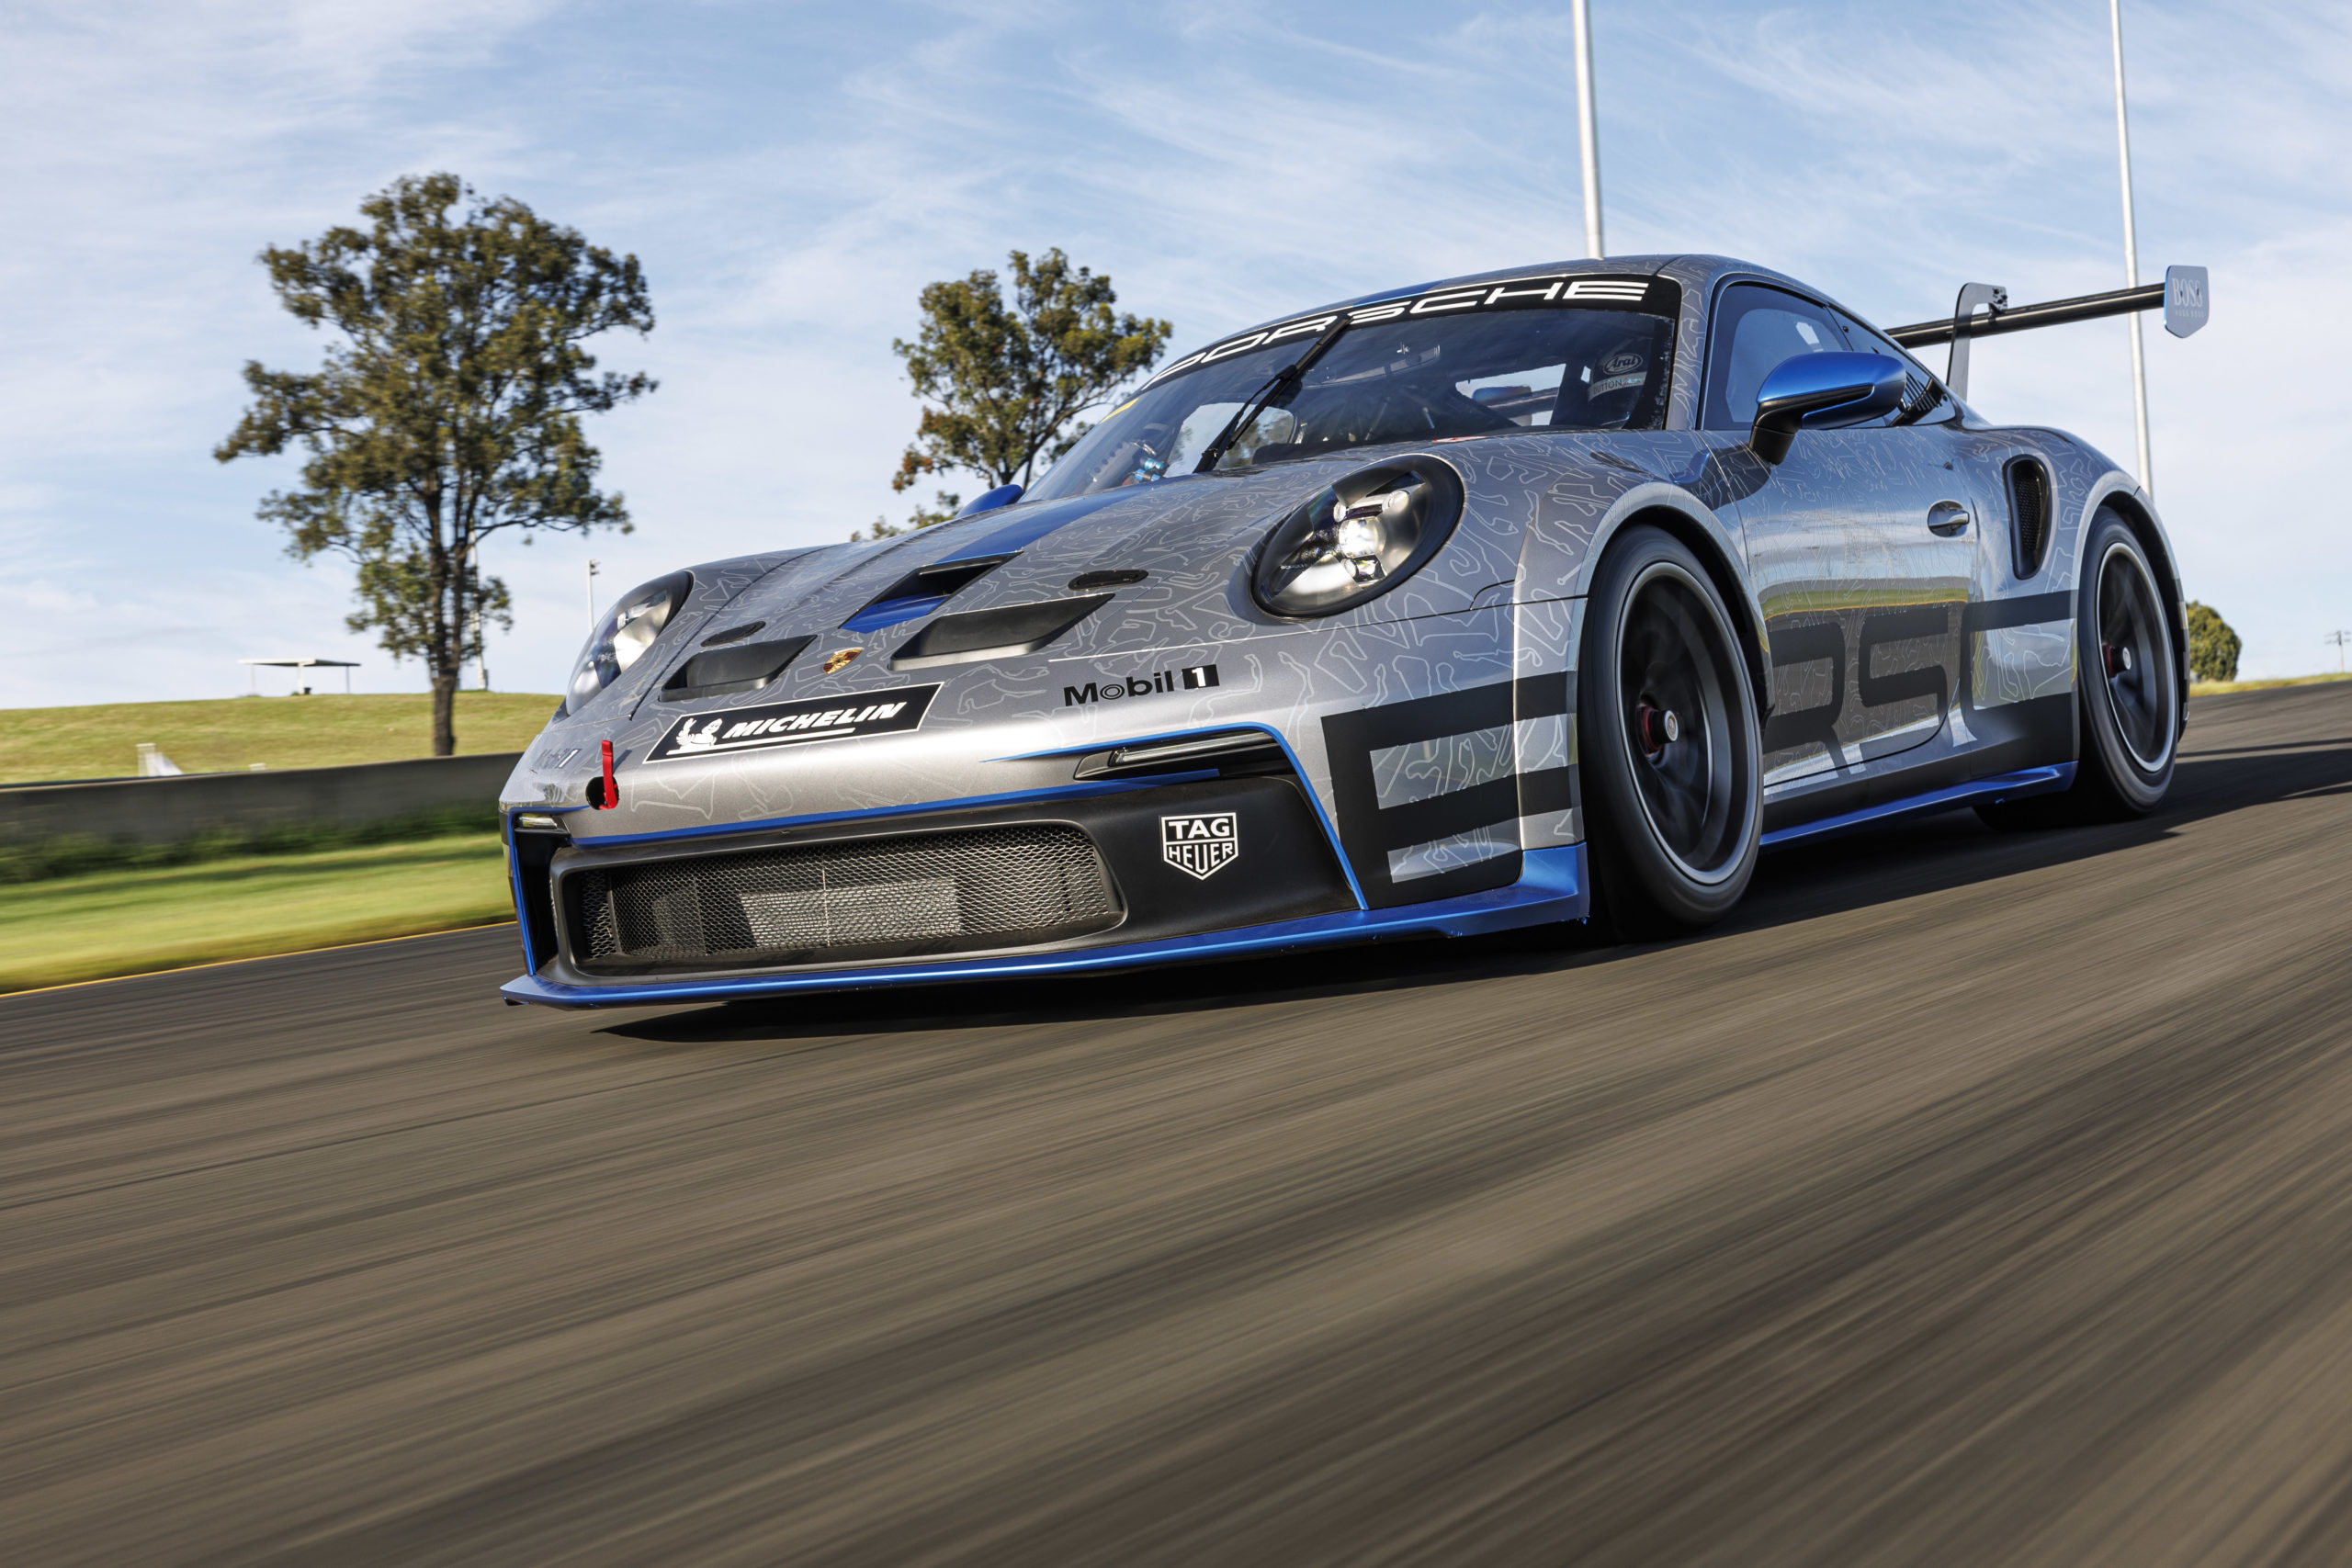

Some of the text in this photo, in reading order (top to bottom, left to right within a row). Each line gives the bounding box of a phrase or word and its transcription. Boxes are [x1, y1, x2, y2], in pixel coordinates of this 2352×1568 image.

[2171, 277, 2203, 308] BOSS
[1141, 280, 1650, 390] PORSCHE
[1593, 378, 1623, 395] DUTTON
[1064, 670, 1174, 706] Mobil
[722, 701, 908, 739] MICHELIN
[1168, 817, 1230, 840] TAG
[1169, 841, 1234, 874] HEUER
